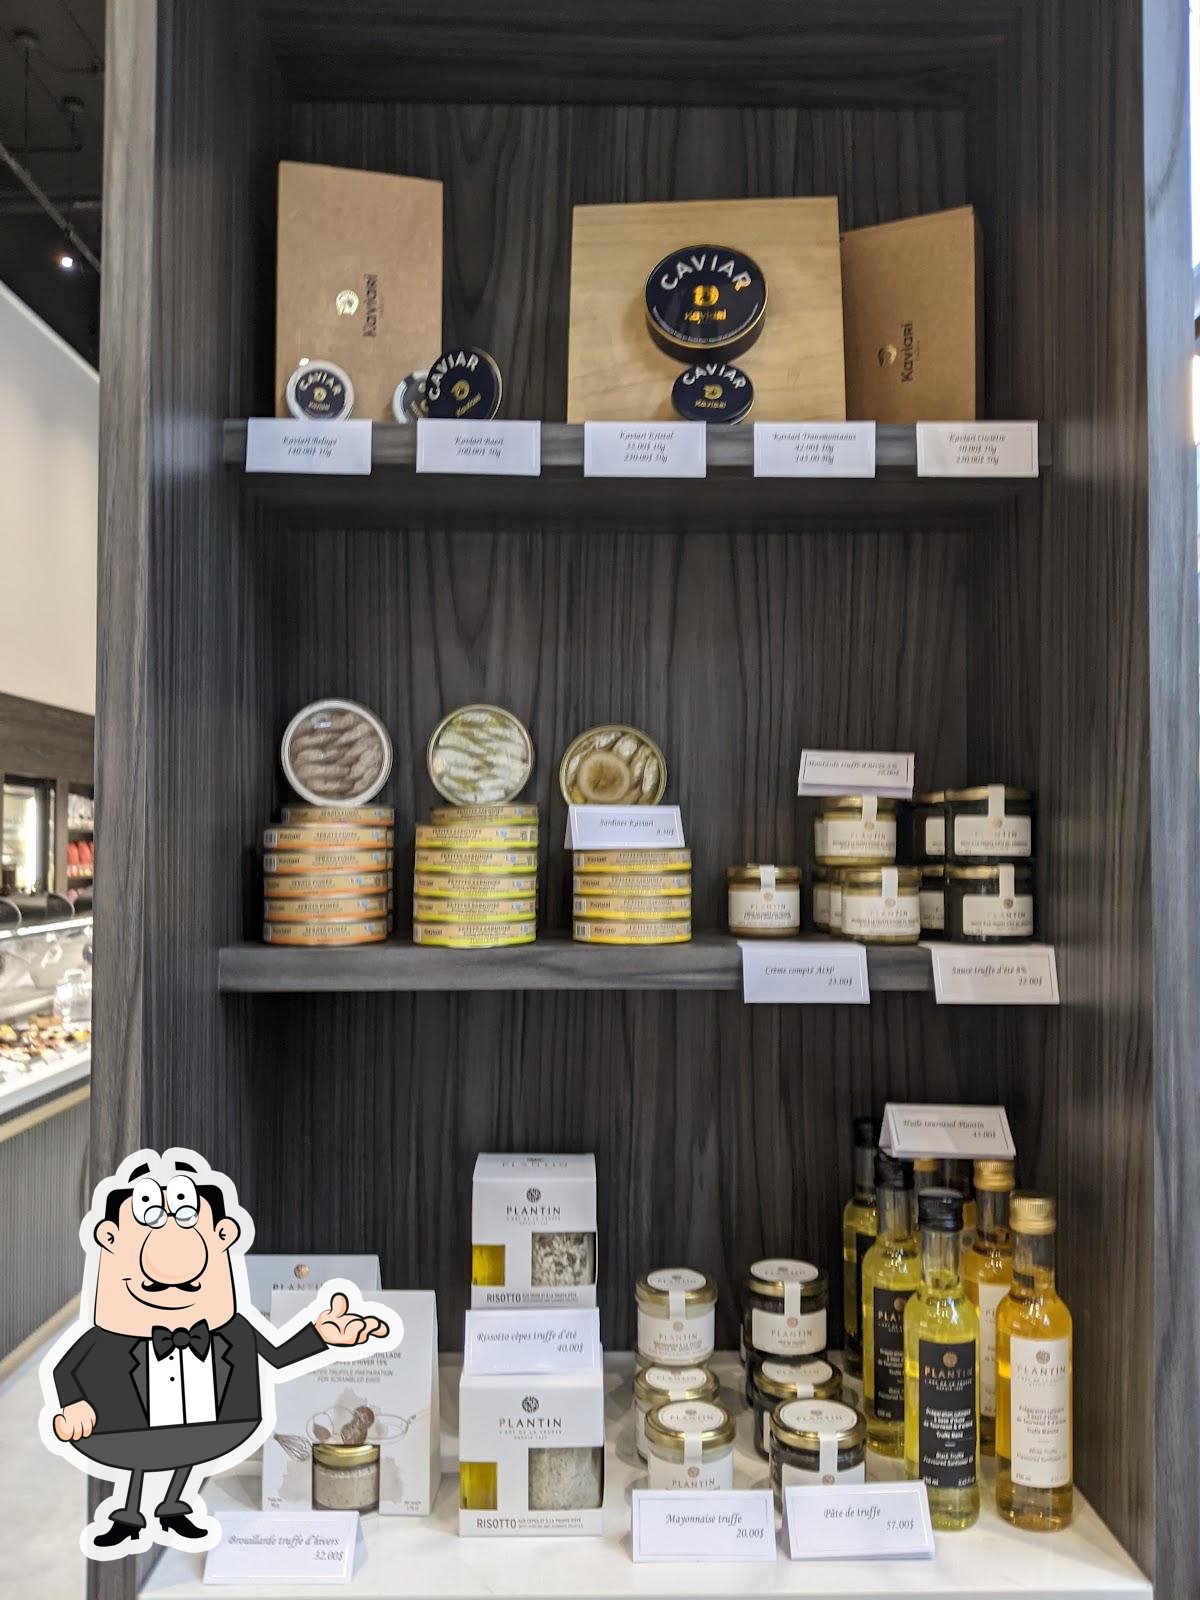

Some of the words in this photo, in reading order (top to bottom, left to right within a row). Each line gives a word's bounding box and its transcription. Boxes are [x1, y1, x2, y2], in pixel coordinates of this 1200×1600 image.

[660, 253, 752, 292] CAVIAR
[901, 322, 913, 382] Kaviari
[429, 351, 480, 401] CAVIAR
[682, 363, 747, 389] CAVIAR
[300, 371, 343, 397] CAVIAR
[974, 964, 995, 977] truffe
[506, 1206, 561, 1216] PLANTIN
[486, 1293, 521, 1303] RISOTTO
[533, 1330, 557, 1344] truffe
[924, 1366, 973, 1379] PLANTIN
[1017, 1365, 1066, 1377] PLANTIN
[499, 1417, 562, 1428] PLANTIN
[672, 1478, 716, 1489] PLANTIN
[823, 1507, 843, 1519] Pâte
[845, 1506, 855, 1518] de
[857, 1505, 881, 1519] truffe
[476, 1519, 517, 1529] RISOTTO
[665, 1513, 716, 1526] Mayonnaise
[717, 1513, 743, 1526] truffe
[886, 1519, 915, 1531] 57.00$
[735, 1528, 765, 1539] 20.00$
[278, 1534, 304, 1548] truffe
[313, 1550, 345, 1561] 32.00$
